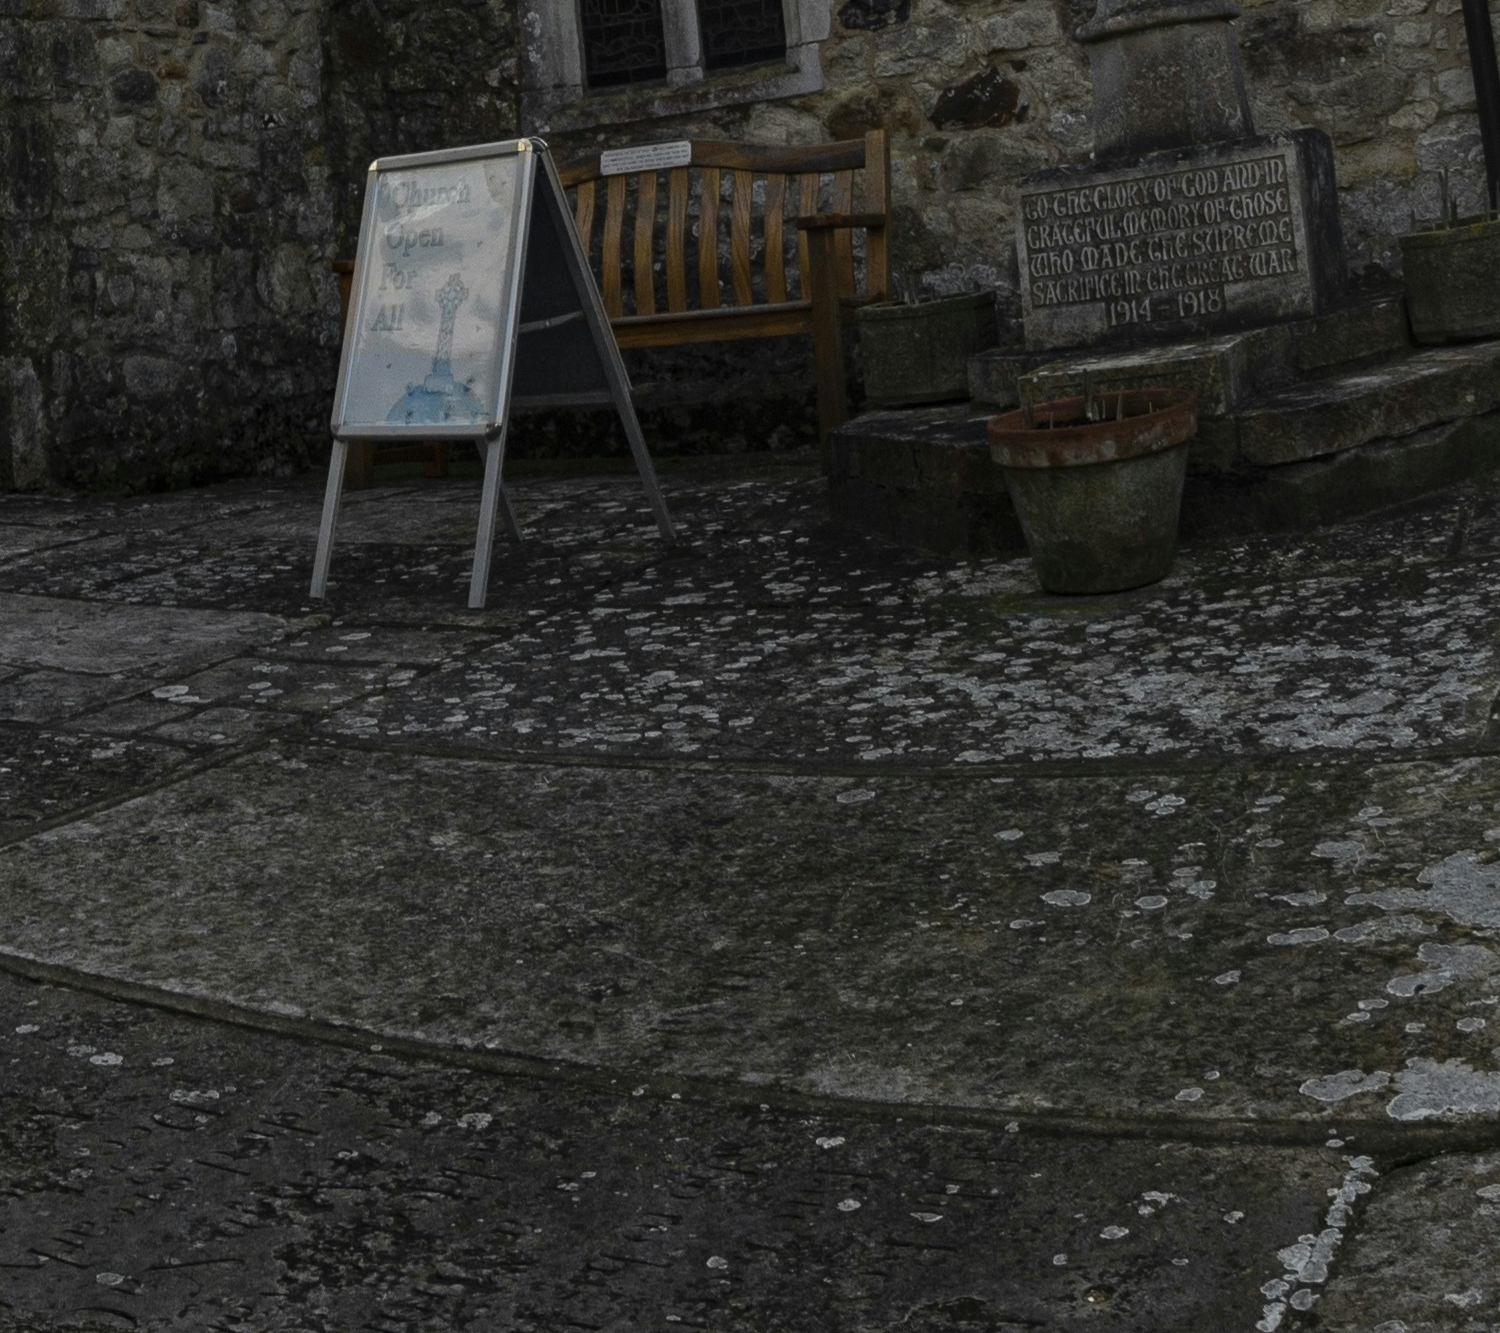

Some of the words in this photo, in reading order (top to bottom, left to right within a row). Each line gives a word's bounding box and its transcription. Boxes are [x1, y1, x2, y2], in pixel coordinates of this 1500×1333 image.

[392, 176, 471, 210] Church
[1053, 189, 1091, 217] THE
[1093, 181, 1150, 213] GLORY
[1153, 178, 1177, 202] OF
[1182, 169, 1218, 198] GOD
[1222, 162, 1260, 193] AND
[1264, 158, 1284, 185] IN
[1027, 214, 1121, 249] GRATEFUL
[1123, 201, 1200, 237] MEMORY
[1204, 199, 1226, 225] OF
[1229, 187, 1288, 220] THOSE
[385, 224, 444, 256] Open
[1030, 249, 1074, 278] WHO
[1080, 239, 1142, 272] MADE
[1147, 232, 1188, 261] THE
[1192, 217, 1292, 256] SUPREME
[378, 262, 417, 291] For
[1033, 271, 1121, 307] SACRIFICE
[1124, 270, 1142, 295] IN
[1146, 264, 1182, 291] THE
[1186, 255, 1245, 287] GREAT
[1249, 248, 1295, 277] WAR
[370, 303, 405, 332] All
[1109, 295, 1152, 327] 1914
[1177, 288, 1222, 318] 1918
